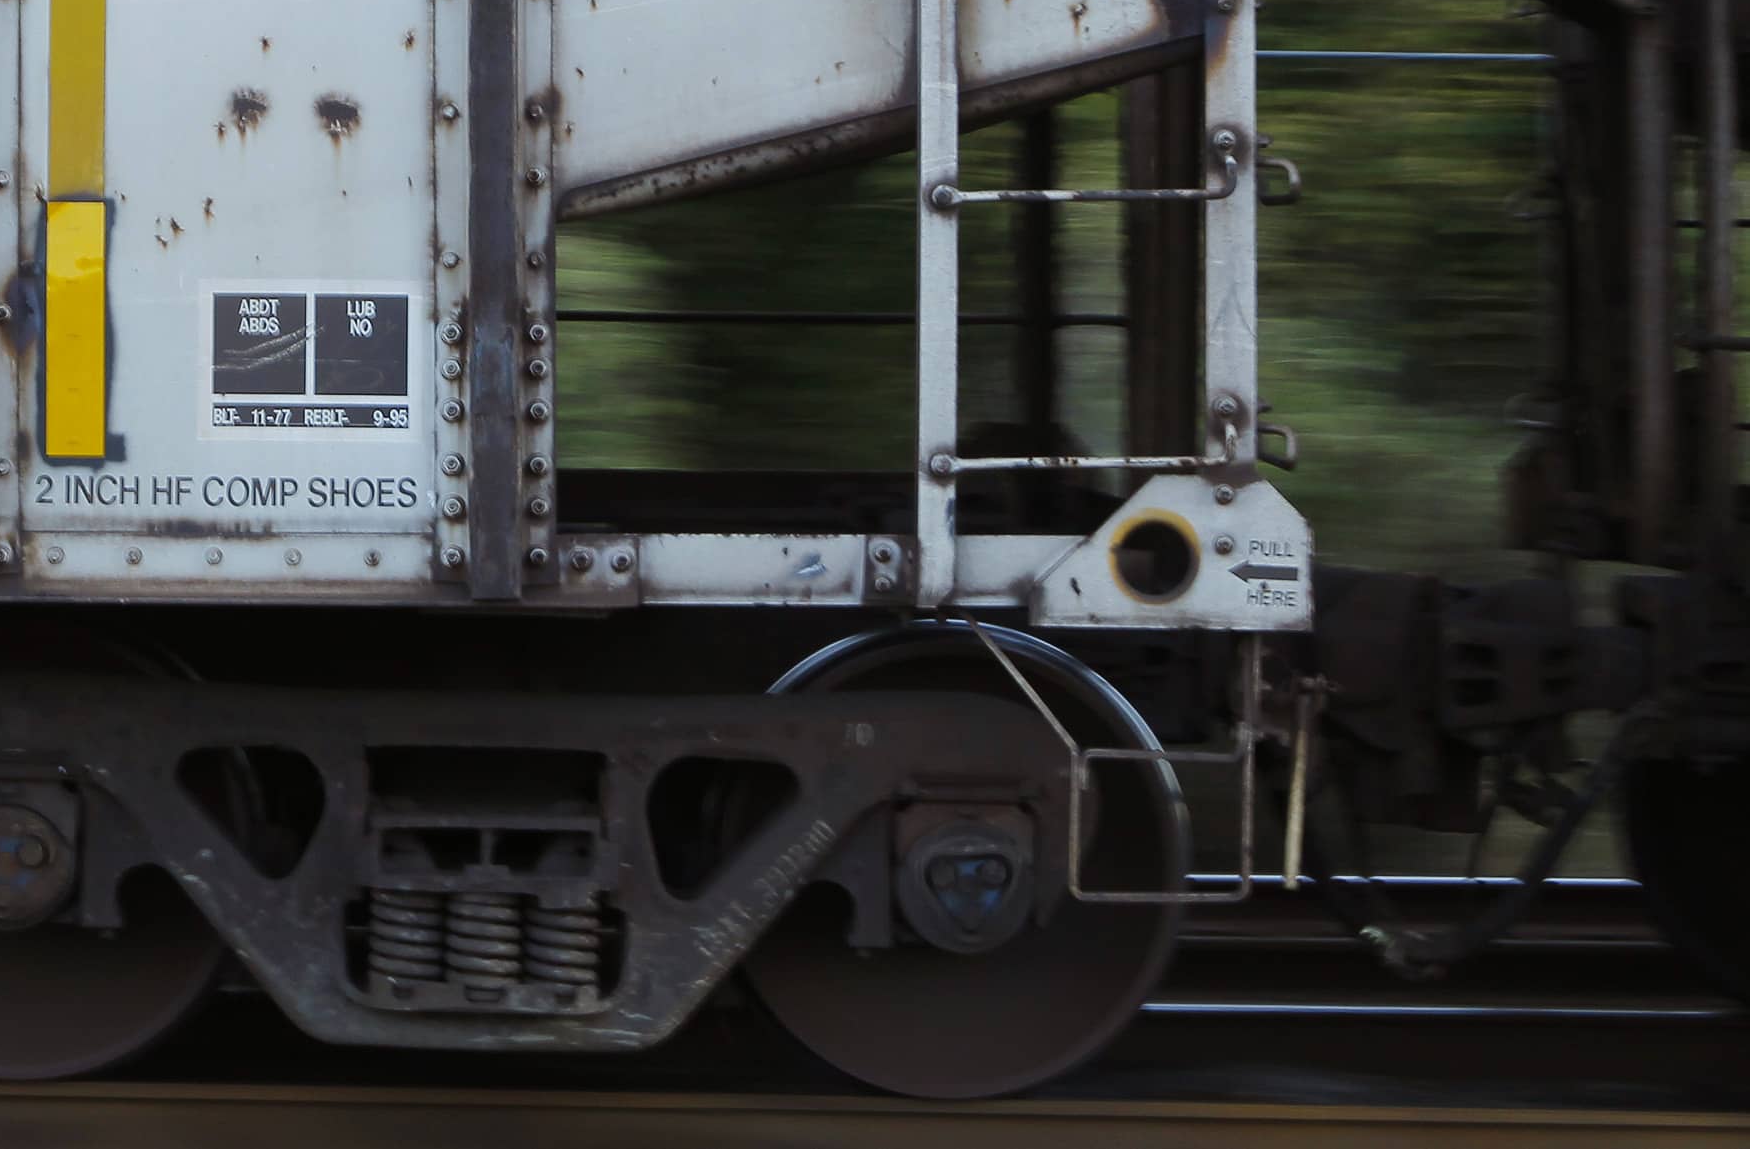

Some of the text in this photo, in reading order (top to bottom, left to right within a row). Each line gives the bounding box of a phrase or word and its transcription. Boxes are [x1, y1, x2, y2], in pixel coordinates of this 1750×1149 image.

[238, 299, 281, 317] ABDT
[347, 300, 377, 318] LUB
[238, 317, 282, 335] ABDS
[350, 318, 373, 336] NO
[213, 408, 408, 429] BLT- 11-77 REBLT- 9-95
[35, 475, 418, 508] 2 INCH HF COMP SHOES
[1249, 540, 1295, 557] PULL
[1247, 589, 1297, 606] HERE
